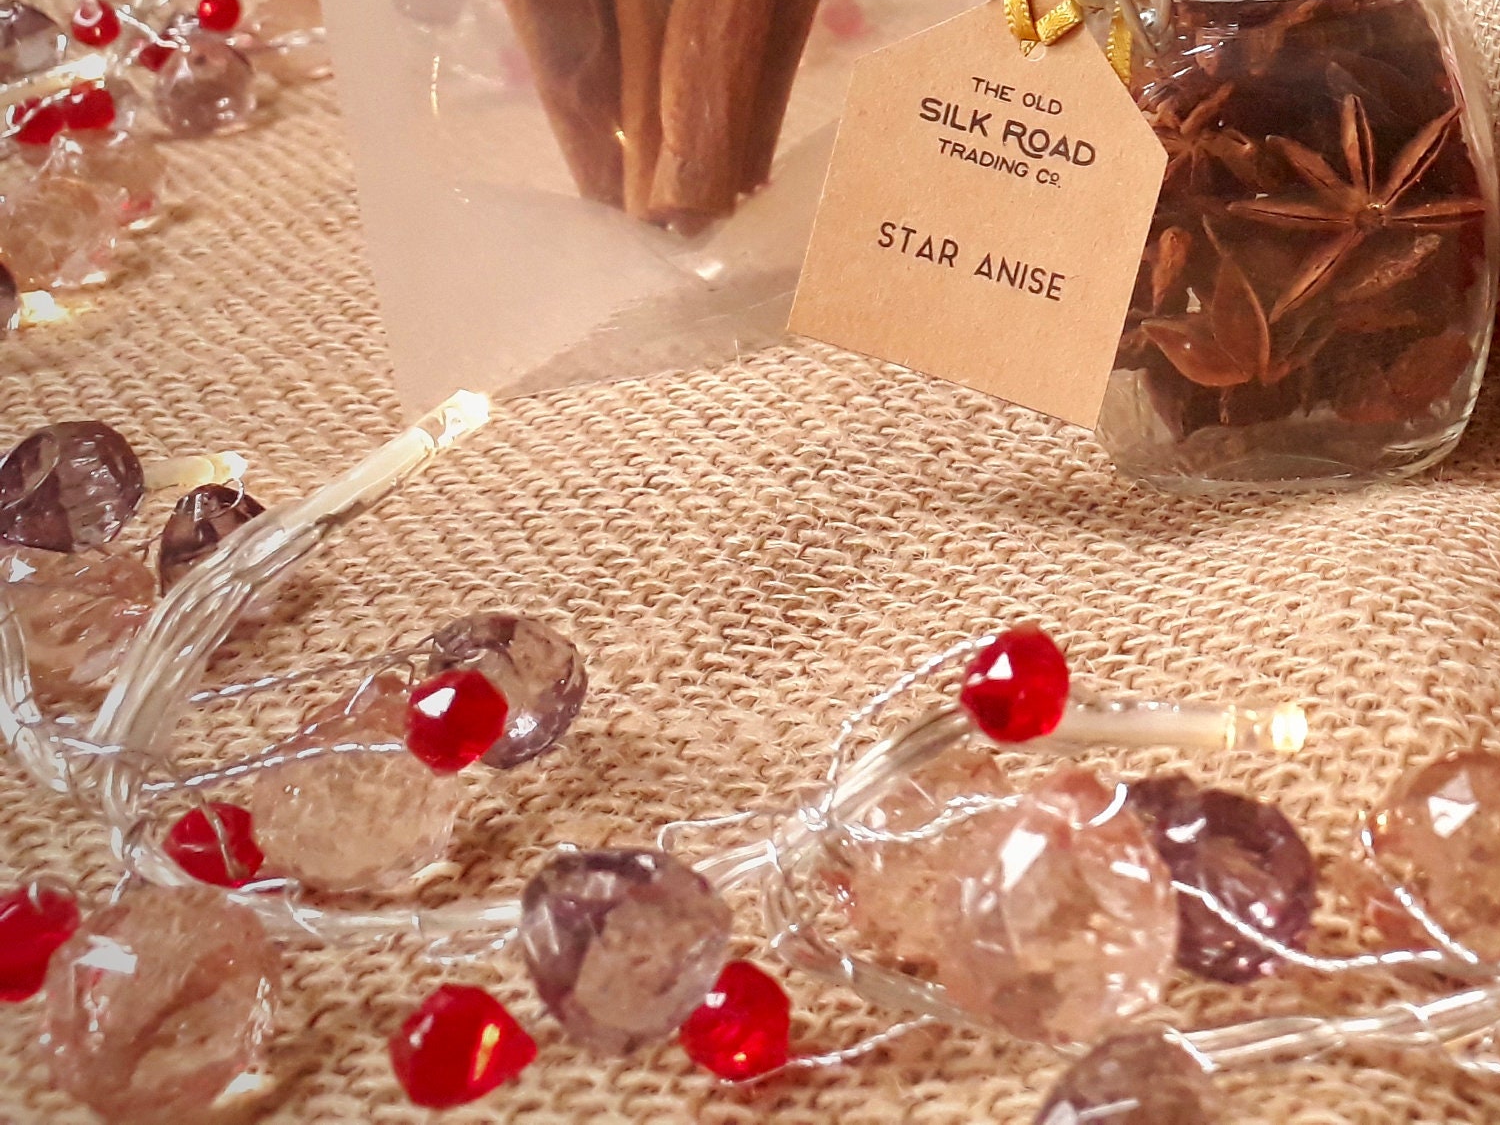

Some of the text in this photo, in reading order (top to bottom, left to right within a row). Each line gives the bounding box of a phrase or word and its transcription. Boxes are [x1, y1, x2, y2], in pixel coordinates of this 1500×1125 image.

[971, 77, 1063, 115] THE OLD
[919, 97, 1096, 166] SILK ROAD
[938, 138, 1028, 178] TRADING
[878, 222, 1066, 301] STAR ANISE
